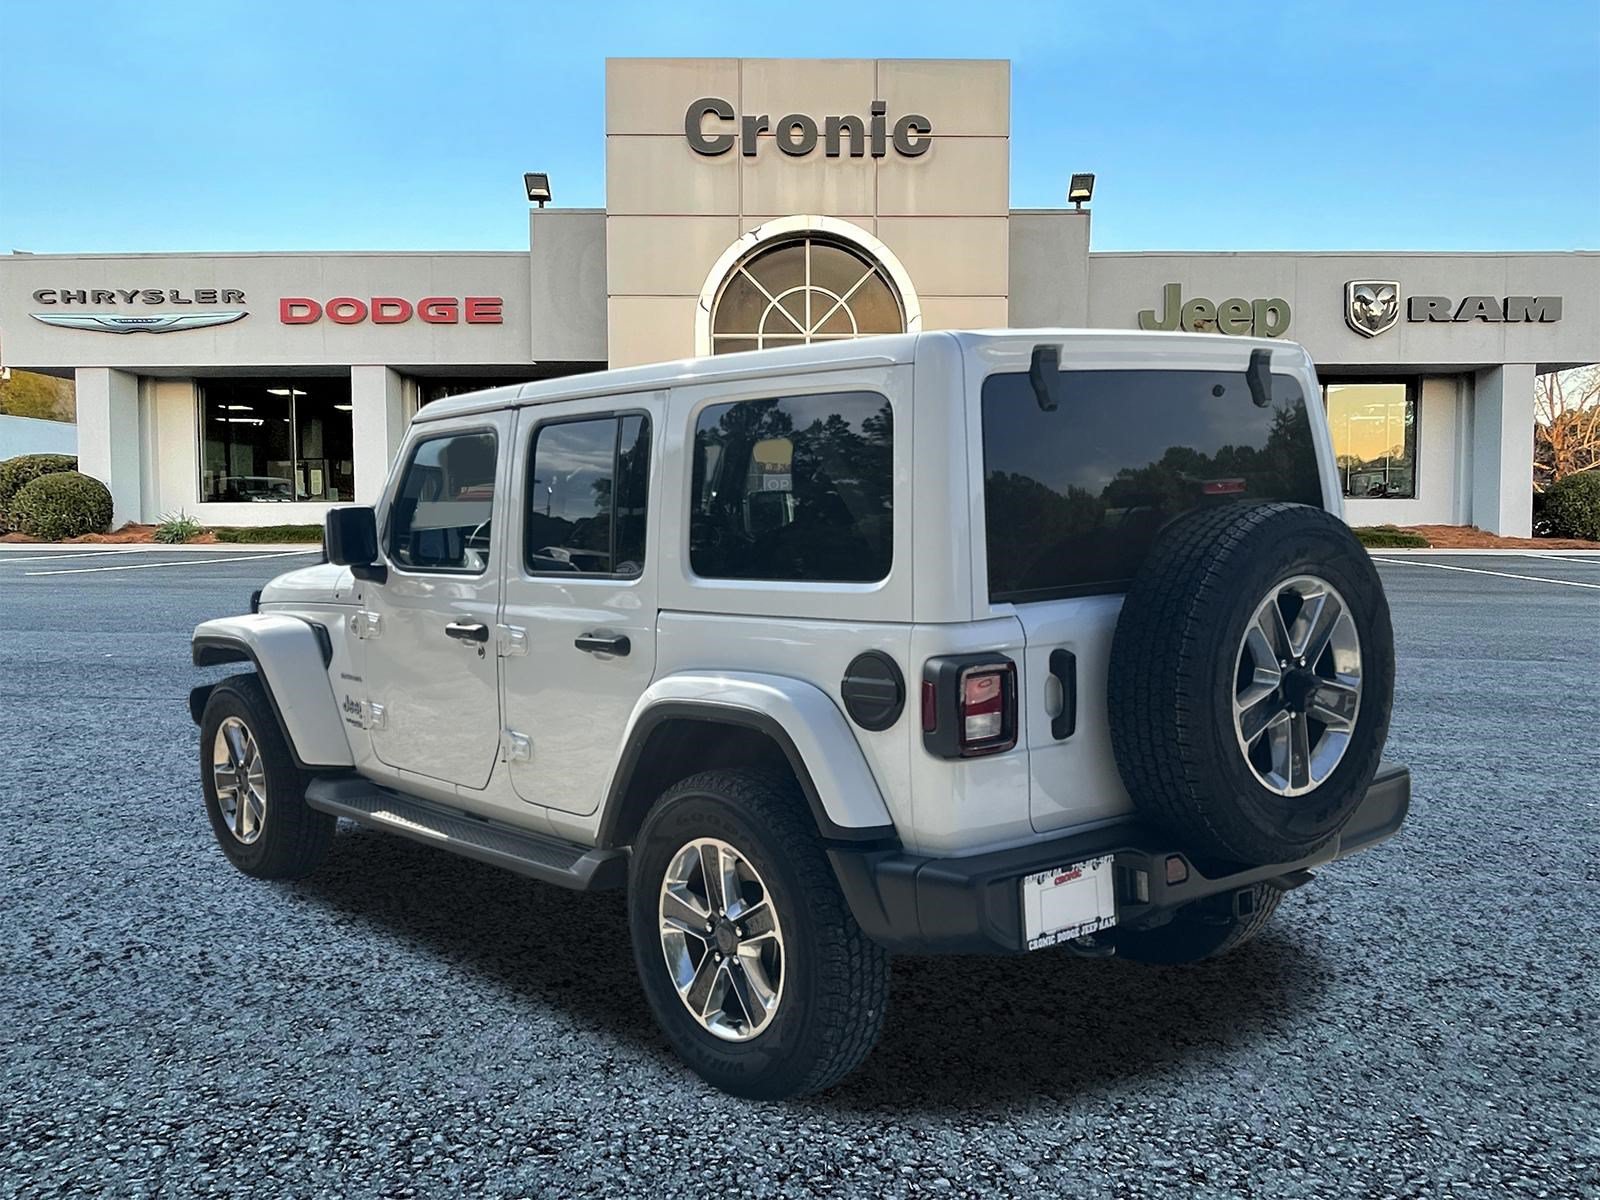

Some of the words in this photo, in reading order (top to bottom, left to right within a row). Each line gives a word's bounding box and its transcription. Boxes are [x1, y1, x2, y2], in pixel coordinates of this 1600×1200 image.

[685, 97, 932, 157] Cronic
[32, 289, 246, 304] CHRYSLER
[280, 297, 503, 324] DODGE
[1138, 283, 1291, 338] Jeep
[1407, 296, 1562, 322] RAM
[1028, 935, 1056, 951] CRONIC
[1056, 927, 1080, 943] DODGE
[1081, 922, 1098, 936] JEEP
